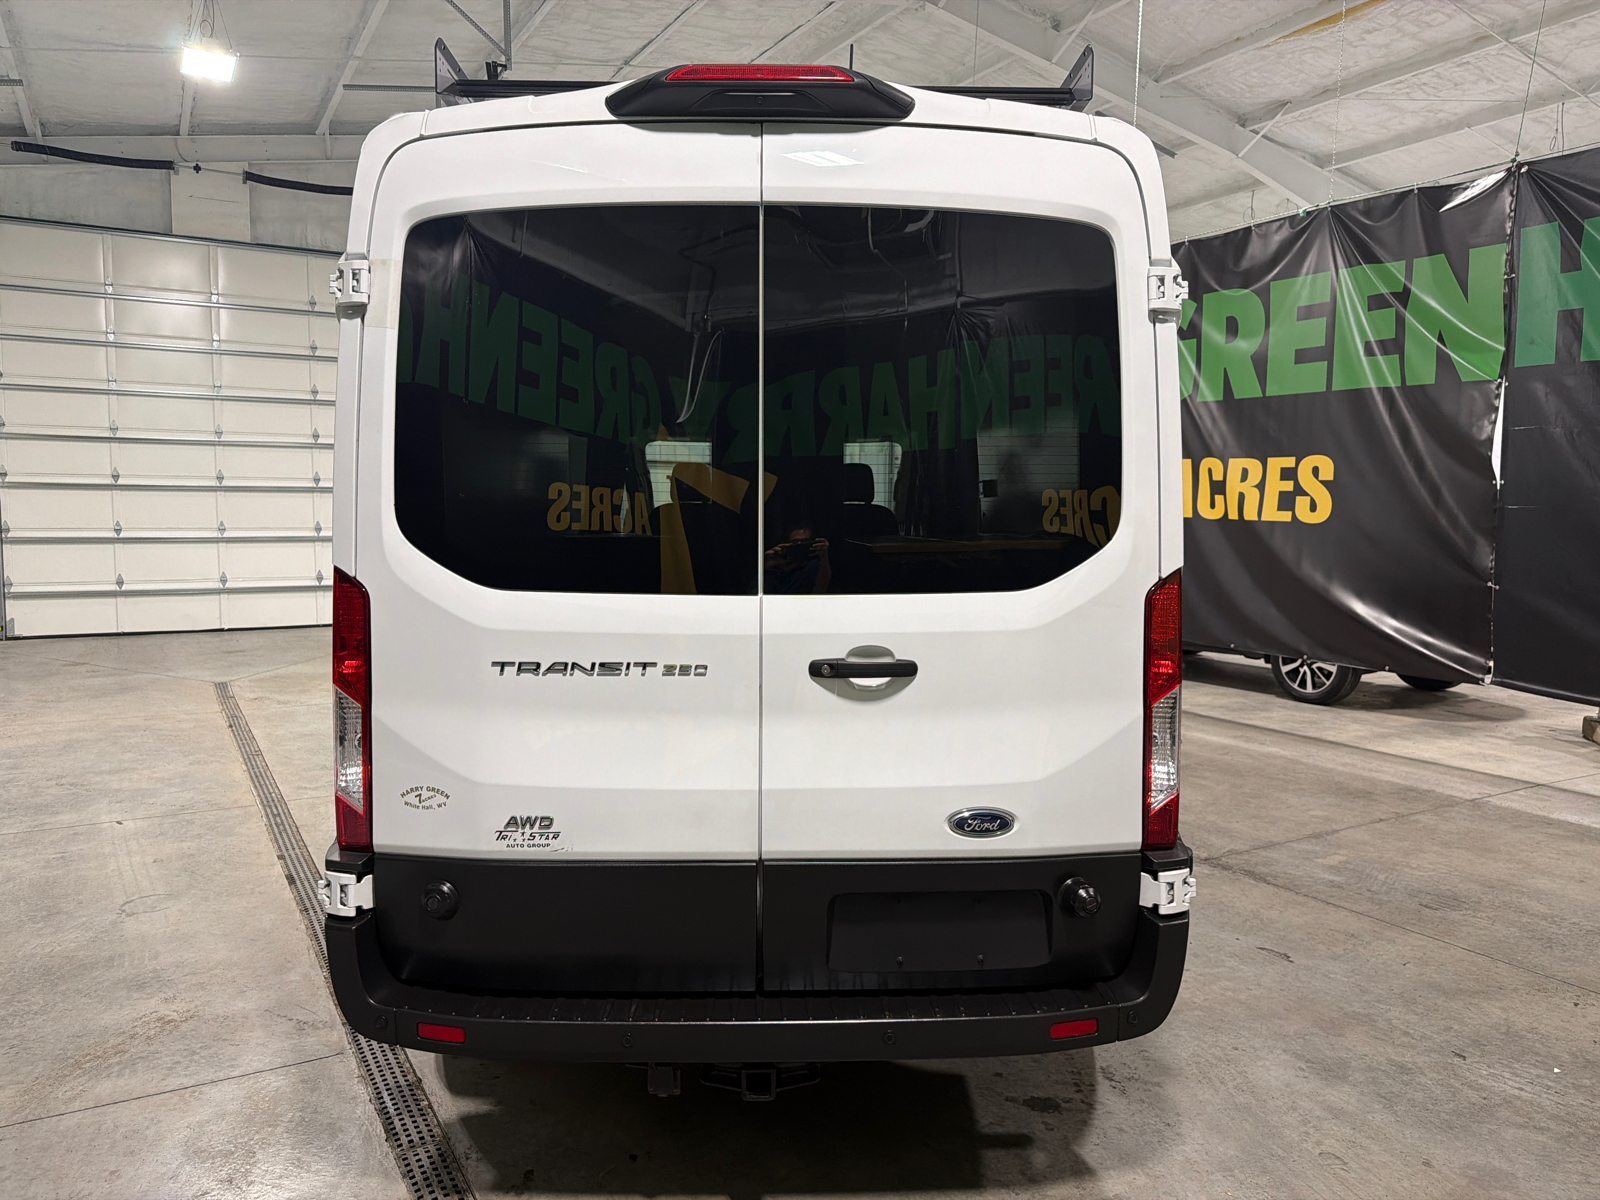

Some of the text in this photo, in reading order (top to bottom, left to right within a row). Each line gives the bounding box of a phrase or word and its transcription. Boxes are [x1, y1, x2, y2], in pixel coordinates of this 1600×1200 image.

[1181, 243, 1507, 402] REEN
[491, 661, 658, 677] TRANSIT
[400, 785, 451, 800] HARRY GREEN
[414, 792, 422, 804] 7
[403, 800, 420, 810] White
[503, 815, 555, 830] AWD
[964, 816, 1001, 831] Ford
[527, 831, 562, 841] STAR
